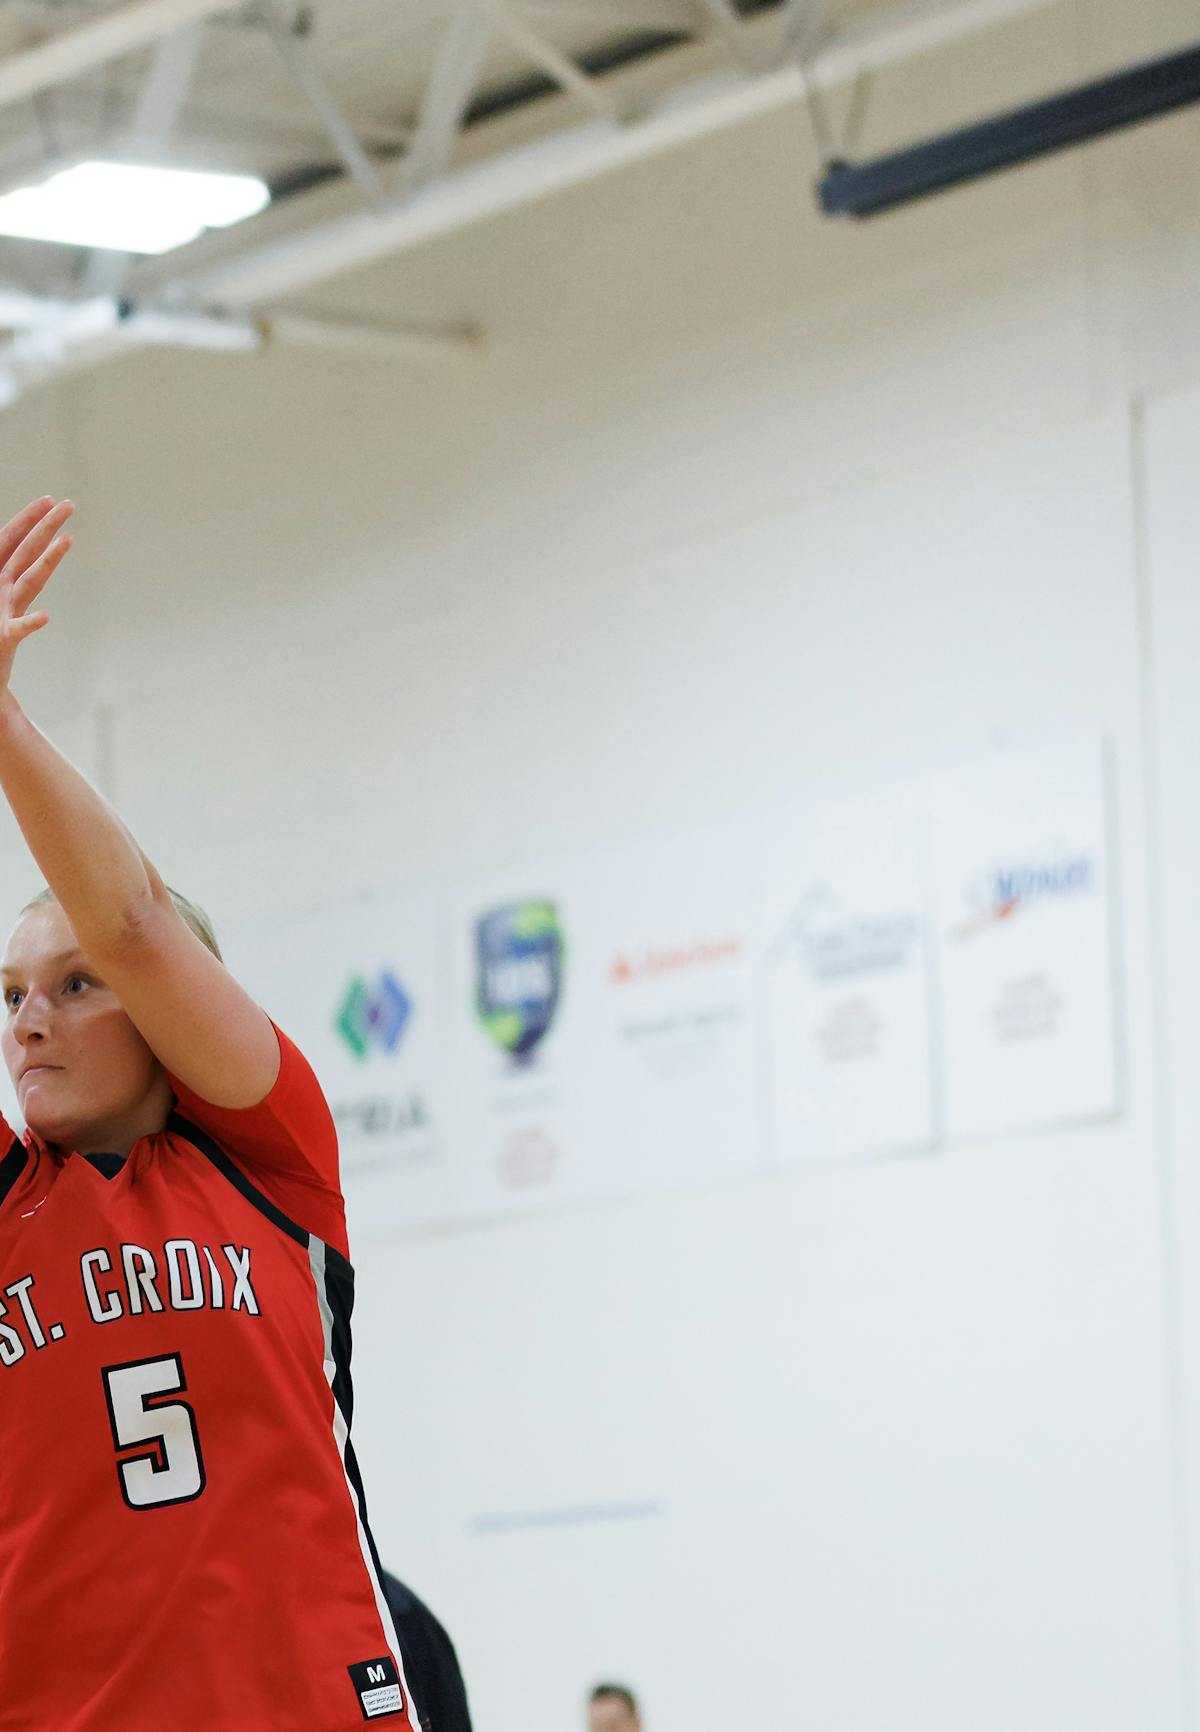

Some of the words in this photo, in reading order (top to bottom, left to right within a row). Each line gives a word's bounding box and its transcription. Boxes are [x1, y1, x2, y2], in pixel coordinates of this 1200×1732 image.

[80, 1238, 261, 1324] CROIX
[101, 1352, 206, 1511] 5
[366, 1664, 386, 1683] M
